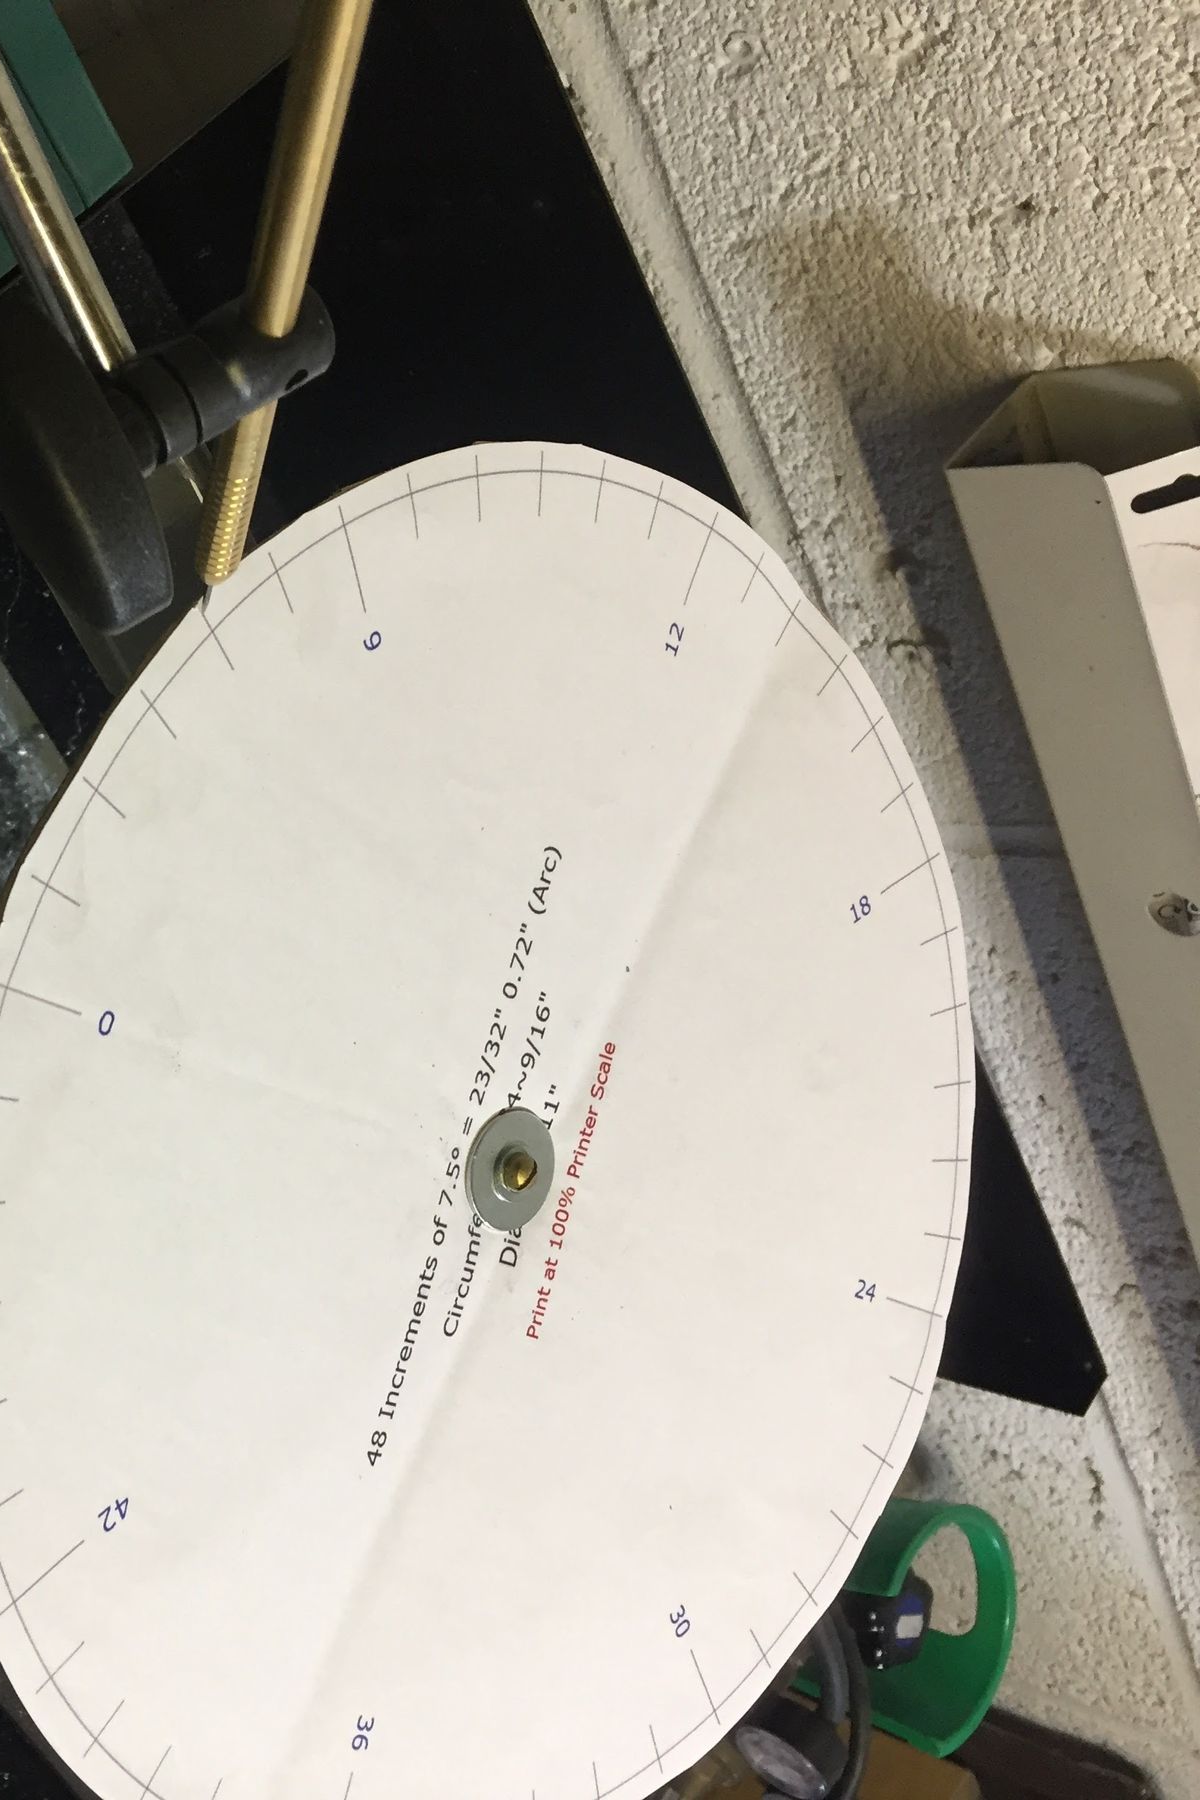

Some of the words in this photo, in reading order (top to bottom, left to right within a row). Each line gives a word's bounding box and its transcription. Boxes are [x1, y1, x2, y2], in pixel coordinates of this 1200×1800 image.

[665, 621, 685, 657] 12
[849, 894, 871, 924] 18
[98, 1010, 116, 1036] 0
[591, 1041, 616, 1100] Scale
[367, 1431, 387, 1466] 48
[378, 1255, 438, 1420] Increments
[433, 1215, 448, 1246] of
[469, 1008, 506, 1105] 23/32"
[503, 923, 533, 999] 0.72"
[528, 846, 562, 915] (Arc)
[567, 1105, 599, 1179] Printer
[443, 1213, 484, 1337] Circumfe
[500, 991, 550, 1113] 4~9/16"
[549, 1186, 576, 1250] 100%
[544, 1257, 559, 1281] at
[854, 1279, 876, 1303] 24
[526, 1286, 551, 1340] Print
[97, 1497, 129, 1532] 42
[669, 1604, 691, 1638] 30
[350, 1714, 375, 1752] 36
